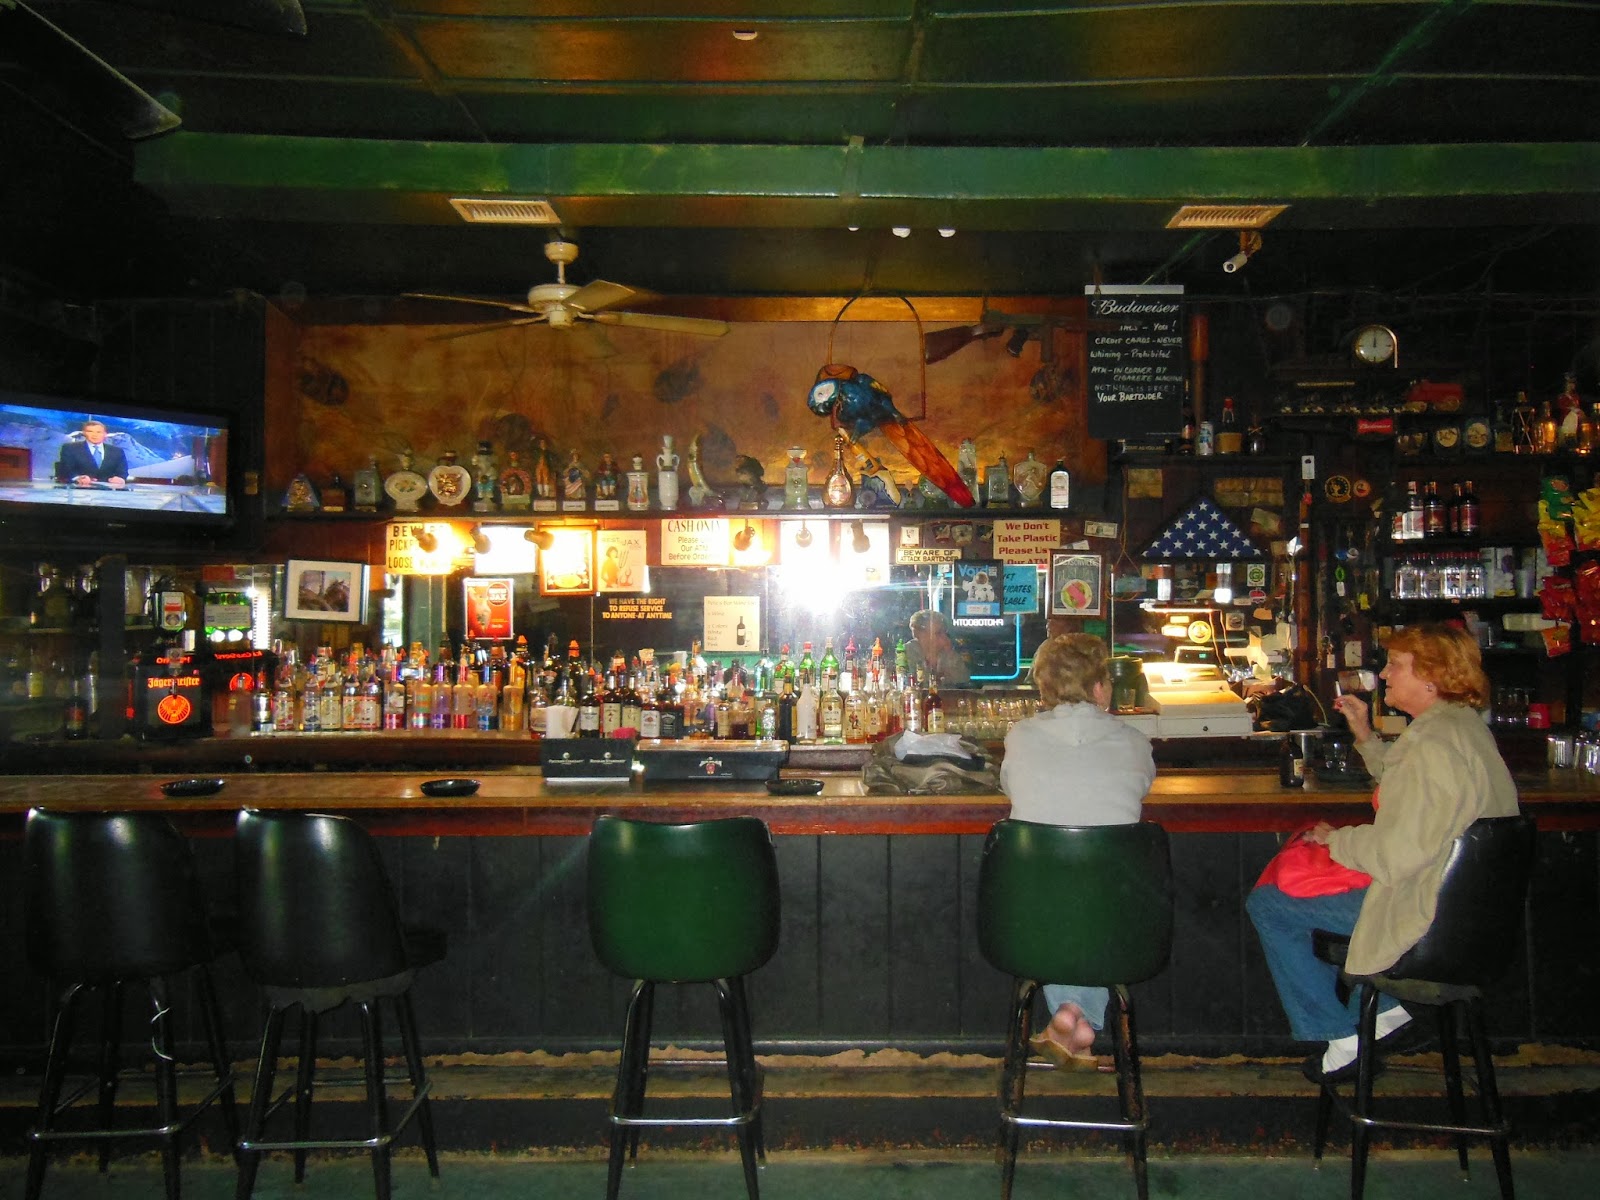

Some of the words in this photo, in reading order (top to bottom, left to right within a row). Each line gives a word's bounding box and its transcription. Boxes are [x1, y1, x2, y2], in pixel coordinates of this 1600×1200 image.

[1091, 300, 1179, 315] Budweiser
[667, 520, 694, 532] CASH
[1004, 522, 1021, 531] We
[1022, 522, 1049, 531] Don't
[677, 536, 698, 544] Please
[996, 535, 1021, 544] Take
[1023, 534, 1057, 543] Plastic
[998, 547, 1031, 556] Please
[669, 553, 691, 561] Before
